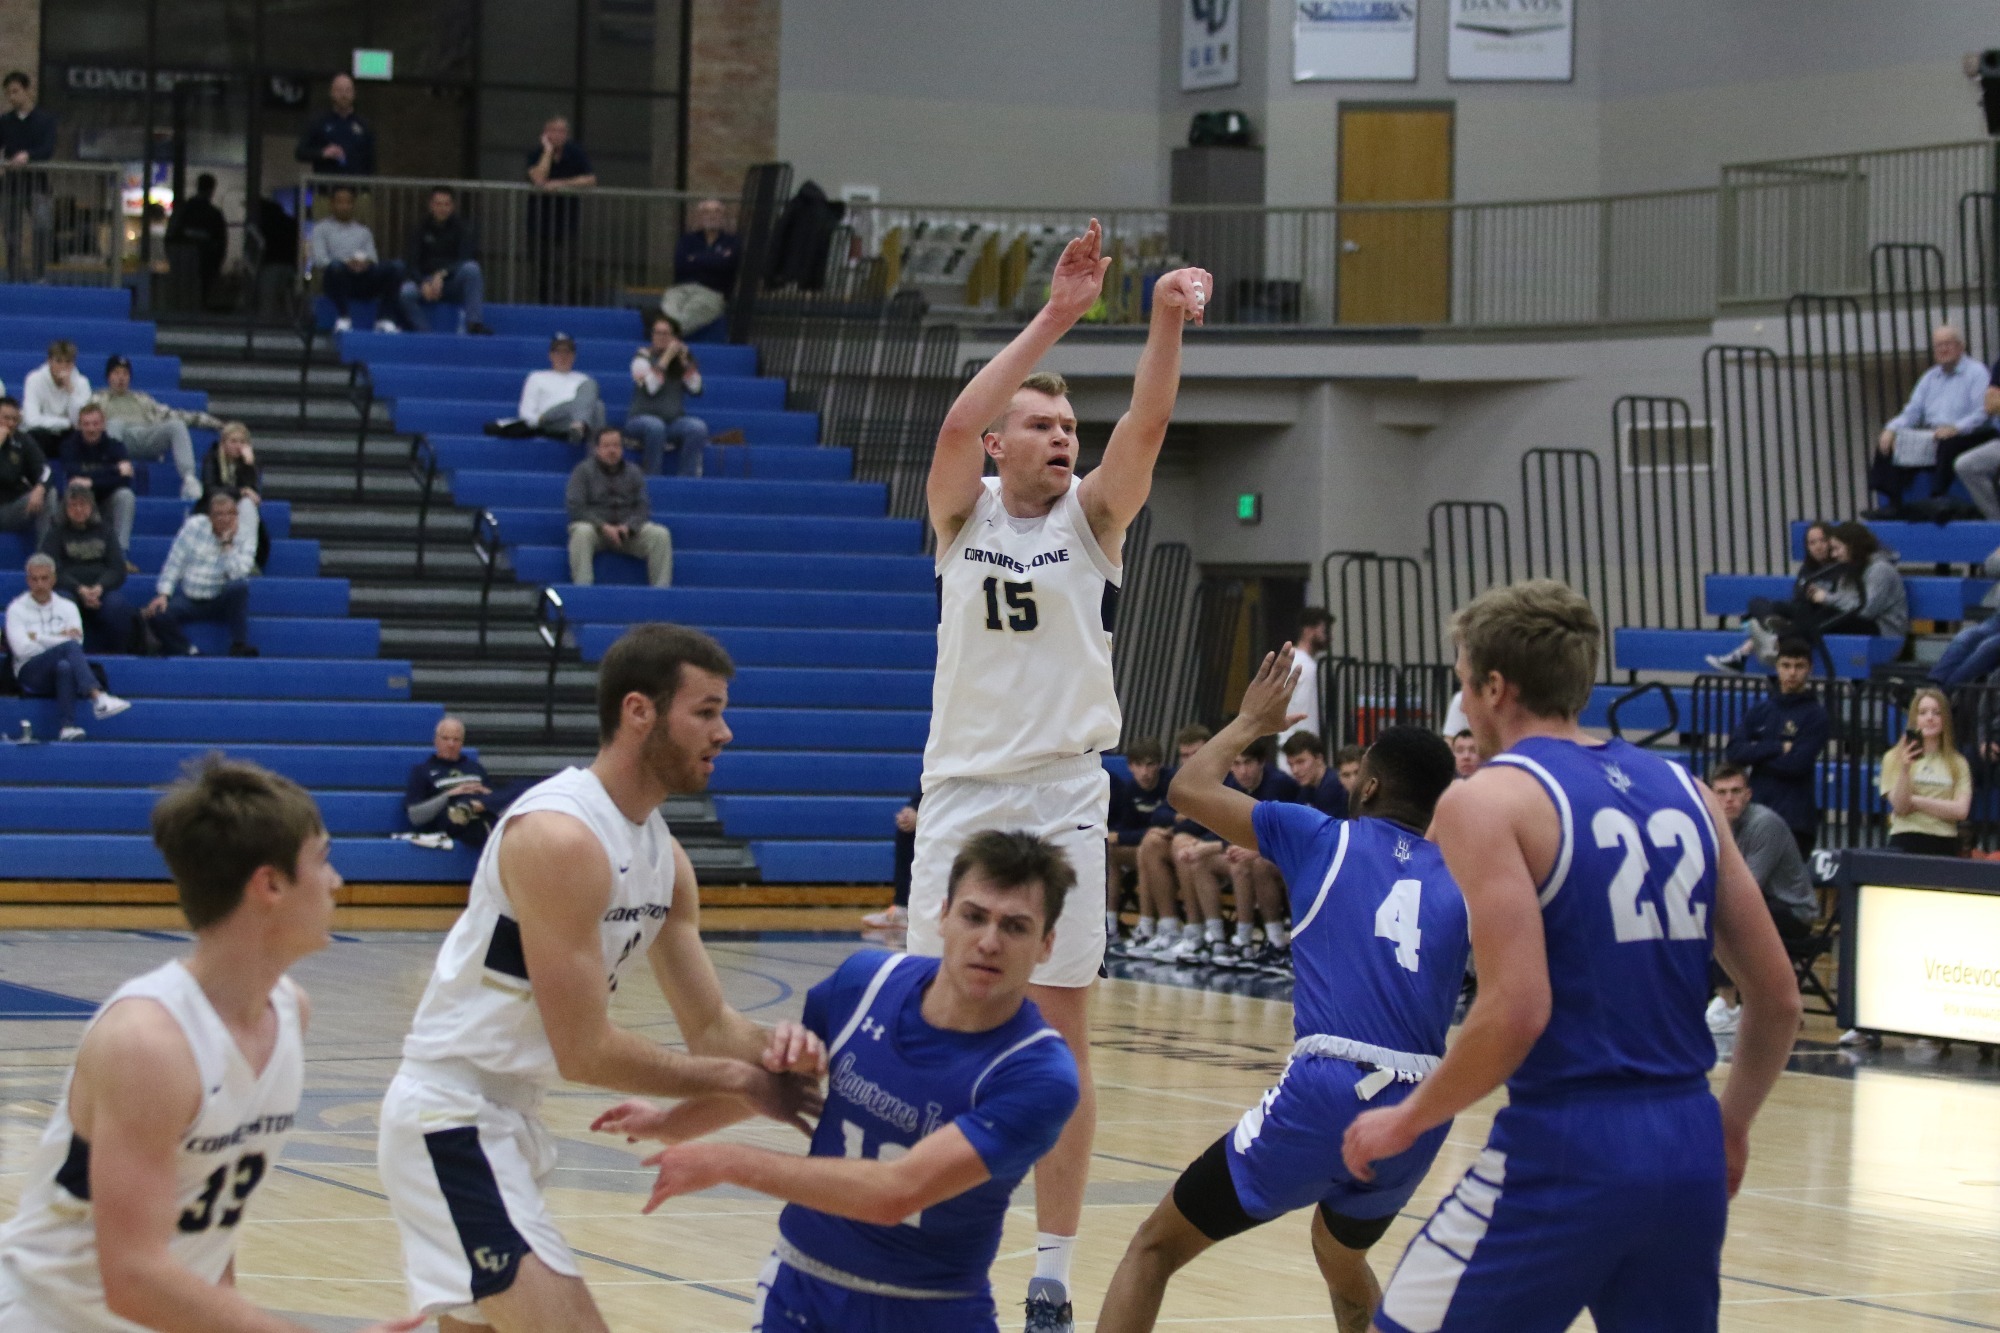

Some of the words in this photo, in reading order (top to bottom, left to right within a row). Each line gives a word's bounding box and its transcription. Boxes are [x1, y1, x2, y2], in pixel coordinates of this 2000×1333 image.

[983, 576, 1038, 632] 15
[1591, 807, 1708, 944] 22
[1374, 879, 1422, 973] 4
